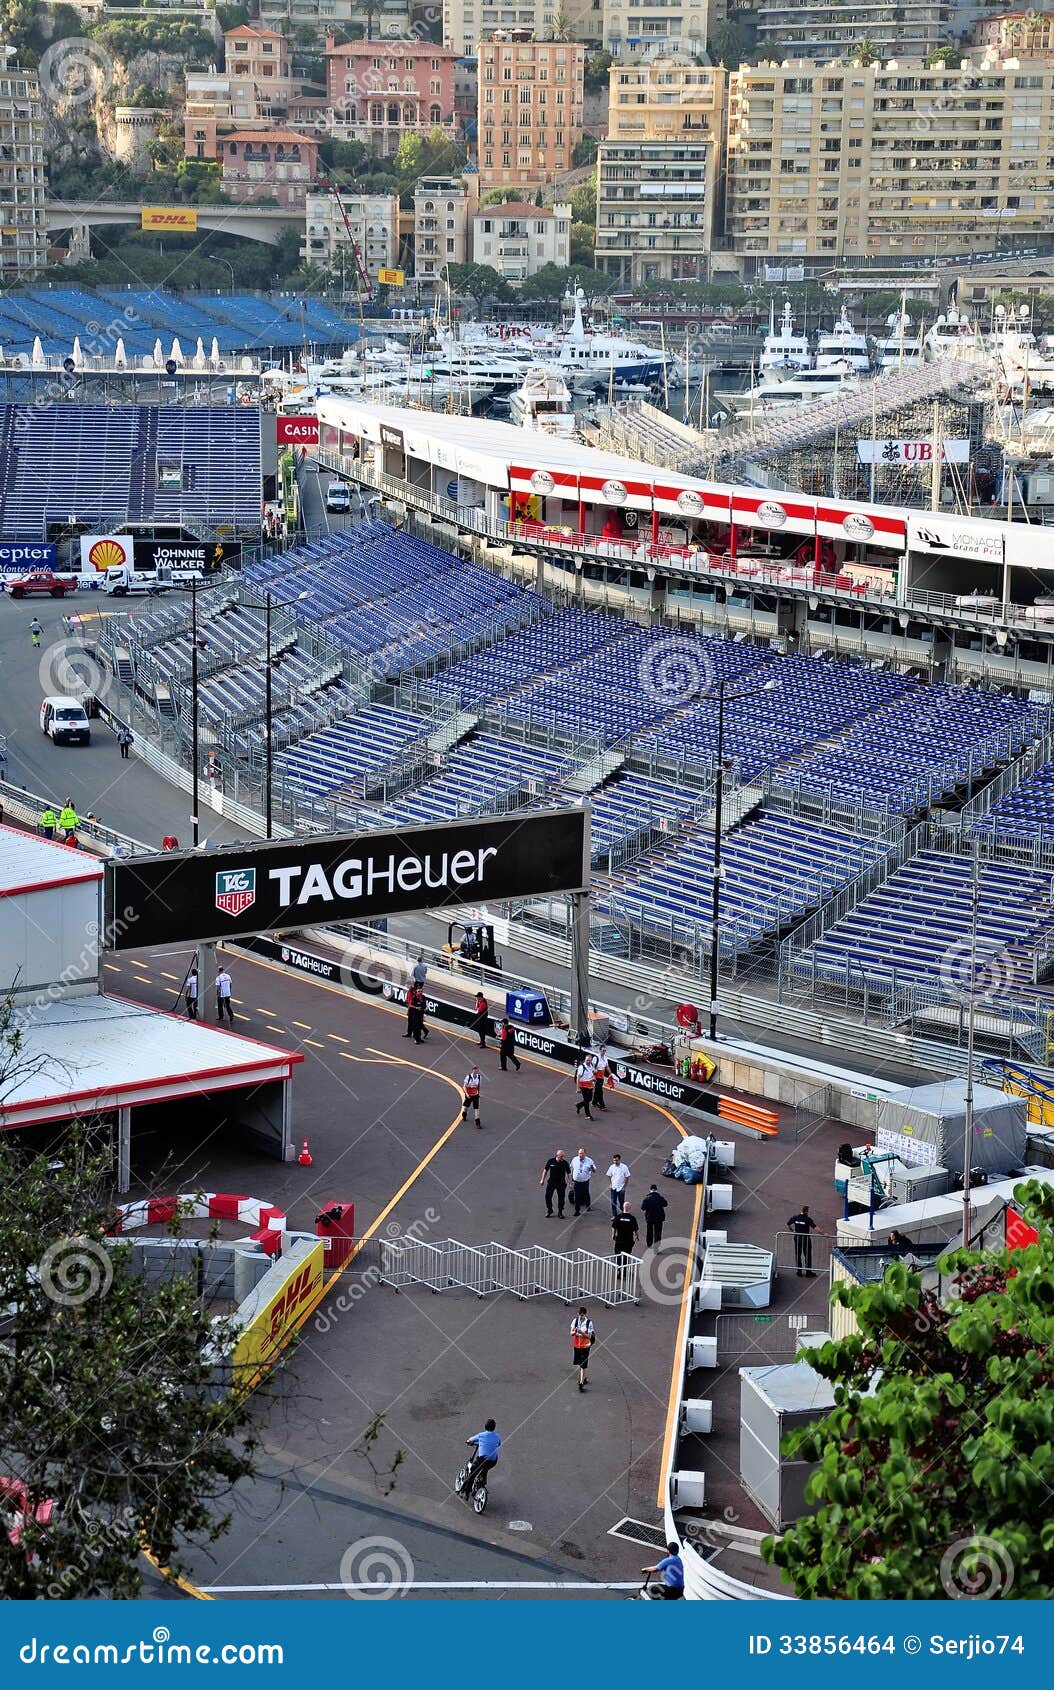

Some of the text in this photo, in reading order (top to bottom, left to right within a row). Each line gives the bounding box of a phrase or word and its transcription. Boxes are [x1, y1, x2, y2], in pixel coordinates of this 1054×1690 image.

[150, 214, 188, 224] DHL
[903, 443, 945, 460] UB
[952, 533, 1003, 549] MONACO
[953, 542, 1002, 556] Grand Prix
[152, 547, 206, 559] JOHNNIE
[154, 558, 205, 569] WALKER
[222, 872, 250, 892] TAG
[218, 893, 253, 913] HEUER
[514, 1029, 555, 1054] GHeuer
[628, 1068, 685, 1099] TAGHeuer
